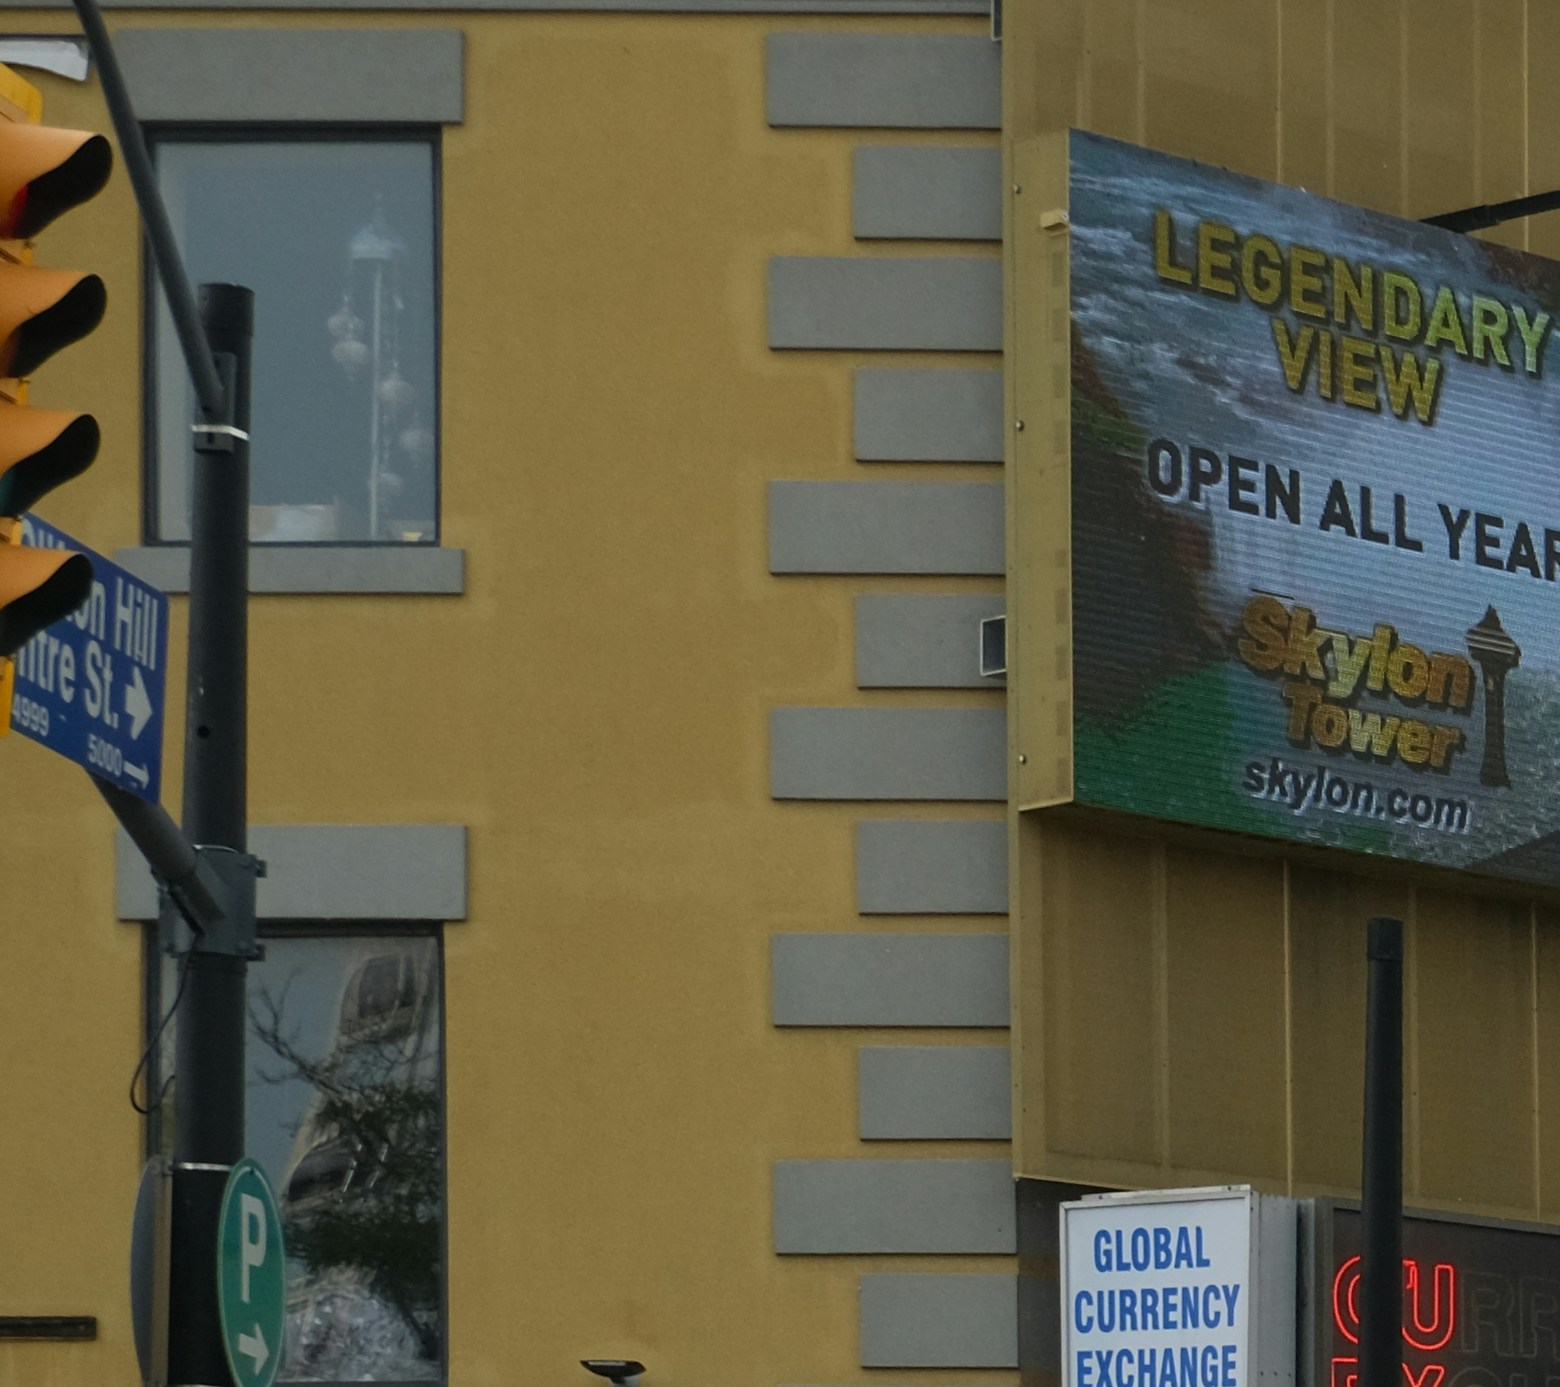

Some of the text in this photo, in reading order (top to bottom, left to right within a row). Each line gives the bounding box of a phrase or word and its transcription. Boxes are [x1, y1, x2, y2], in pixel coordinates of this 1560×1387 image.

[1153, 209, 1552, 376] LEGENDARY
[1271, 317, 1444, 425] VIEW
[1148, 437, 1301, 526] OPEN
[1320, 480, 1423, 552] ALL
[115, 577, 158, 670] Hill
[1236, 592, 1473, 713] Skylon
[18, 630, 119, 728] ntre St.
[1281, 684, 1464, 770] Tower
[1242, 760, 1469, 831] skylon.com
[238, 1194, 267, 1302] P
[1093, 1226, 1211, 1274] GLOBAL
[1074, 1283, 1241, 1335] CURRENCY
